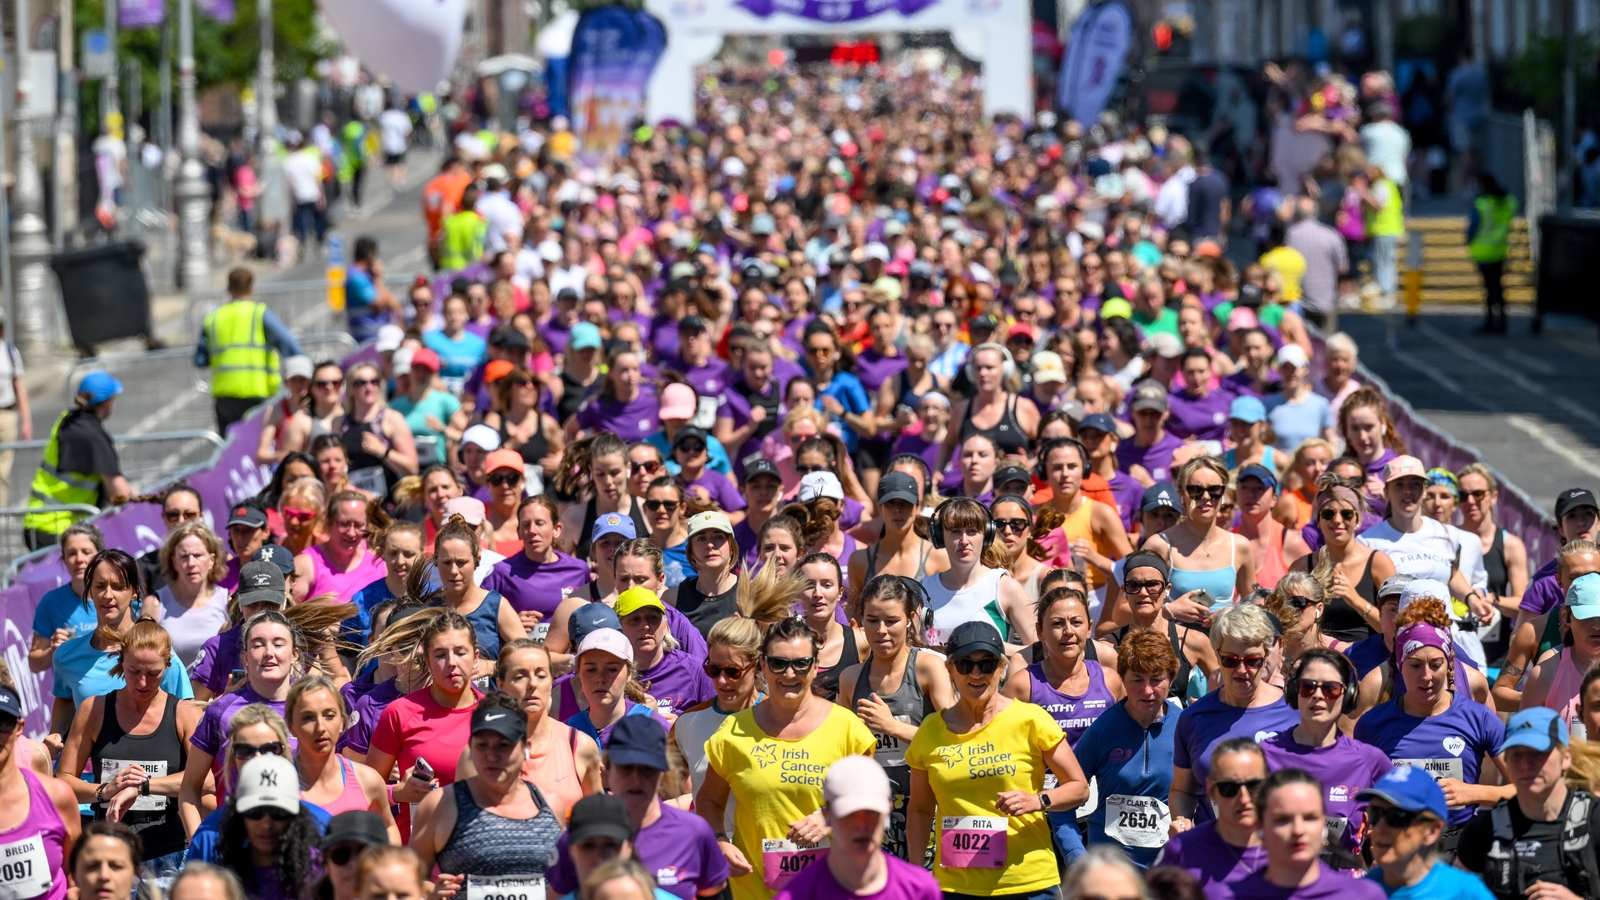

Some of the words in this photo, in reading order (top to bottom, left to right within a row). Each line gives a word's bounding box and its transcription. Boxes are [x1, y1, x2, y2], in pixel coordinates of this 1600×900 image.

[782, 748, 810, 760] Irish
[968, 742, 995, 756] Irish
[781, 760, 826, 774] Cancer
[968, 752, 1012, 768] Cancer
[1424, 762, 1451, 772] ANNIE
[969, 764, 1017, 780] Society
[1126, 799, 1149, 807] CLARE
[972, 820, 993, 829] RITA
[1118, 811, 1158, 830] 2654
[952, 833, 991, 851] 4022
[5, 843, 36, 858] BREDA
[494, 877, 541, 888] VERONICA
